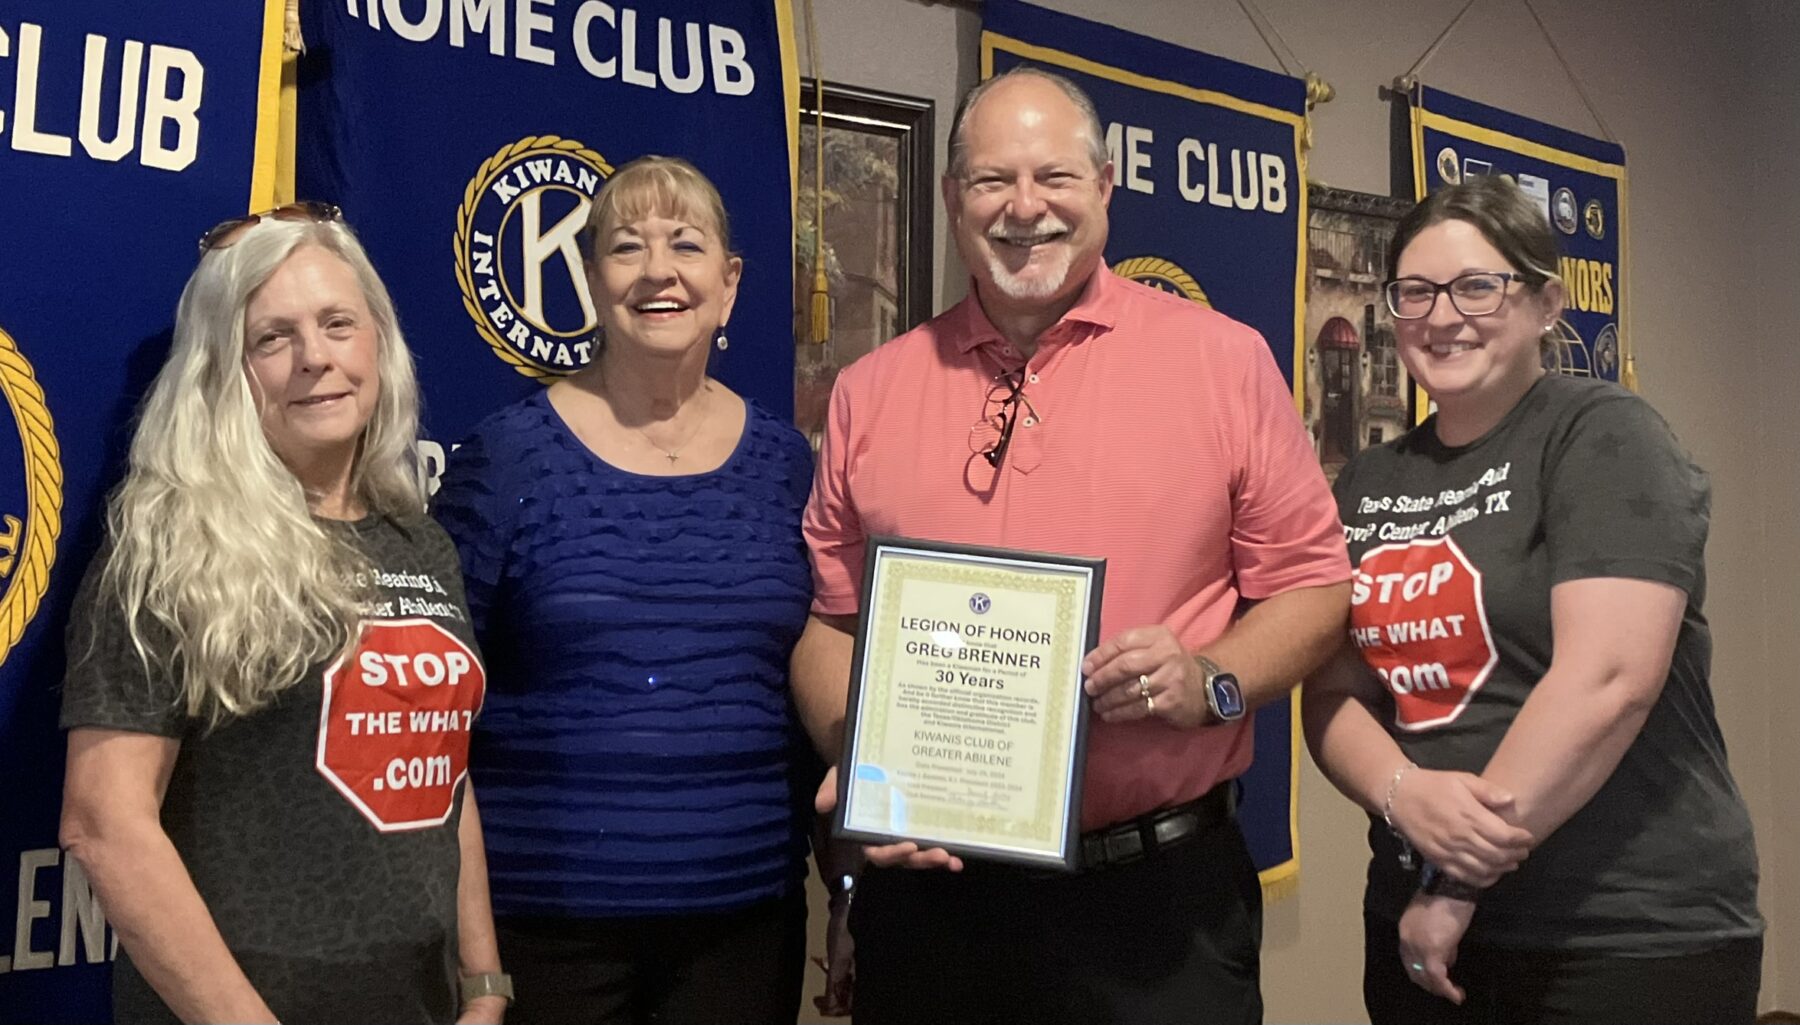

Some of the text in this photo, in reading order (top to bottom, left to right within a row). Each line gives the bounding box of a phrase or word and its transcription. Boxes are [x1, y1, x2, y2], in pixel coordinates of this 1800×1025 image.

[572, 0, 756, 97] CLUB
[0, 22, 204, 172] LUB
[492, 158, 598, 205] KIWAN
[1178, 137, 1287, 214] CLUB
[473, 231, 598, 367] INTERNAT
[1558, 257, 1614, 315] NORS
[1392, 495, 1434, 514] State
[1484, 490, 1512, 515] TX
[1351, 561, 1454, 605] STOP
[901, 616, 1051, 646] LEGION OF HONOR
[1386, 614, 1465, 646] WHAT
[359, 651, 471, 687] STOP
[906, 641, 1041, 669] GREG BRENNER
[935, 669, 1004, 690] 30 Years
[1377, 662, 1451, 694] om
[345, 710, 473, 736] THE WHAT
[914, 729, 1014, 751] KIWANIS CLUB OF
[373, 754, 451, 791] .com
[963, 751, 1012, 767] ABILENE
[0, 848, 118, 974] EN
